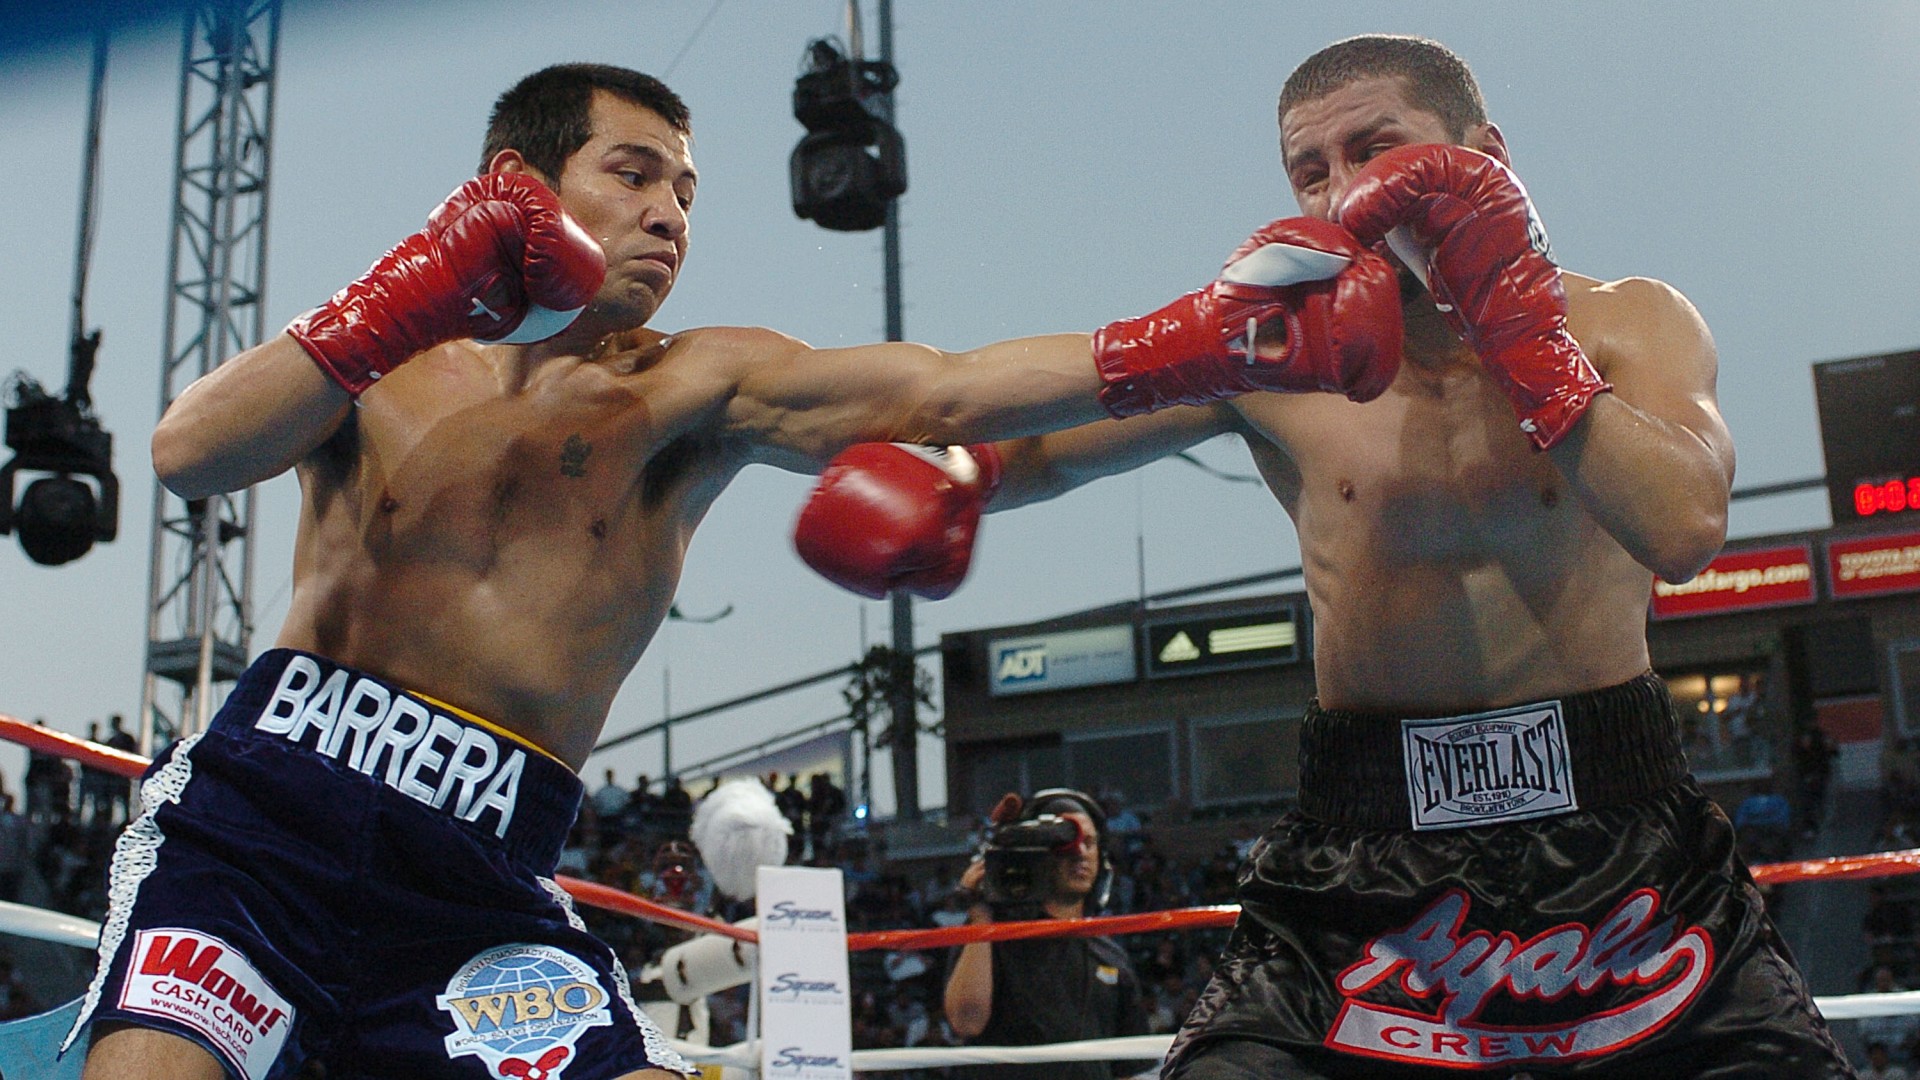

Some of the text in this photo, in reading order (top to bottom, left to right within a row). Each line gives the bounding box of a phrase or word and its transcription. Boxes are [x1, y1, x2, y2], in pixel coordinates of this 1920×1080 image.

[1001, 649, 1046, 681] ADT
[255, 655, 527, 838] BARRERA
[1414, 714, 1561, 814] EVERLAST
[140, 936, 283, 1037] Wow!
[1336, 888, 1690, 1026] Ayala
[152, 981, 253, 1045] CASH CARD
[447, 982, 602, 1034] WBO
[1380, 1025, 1579, 1057] CREW
